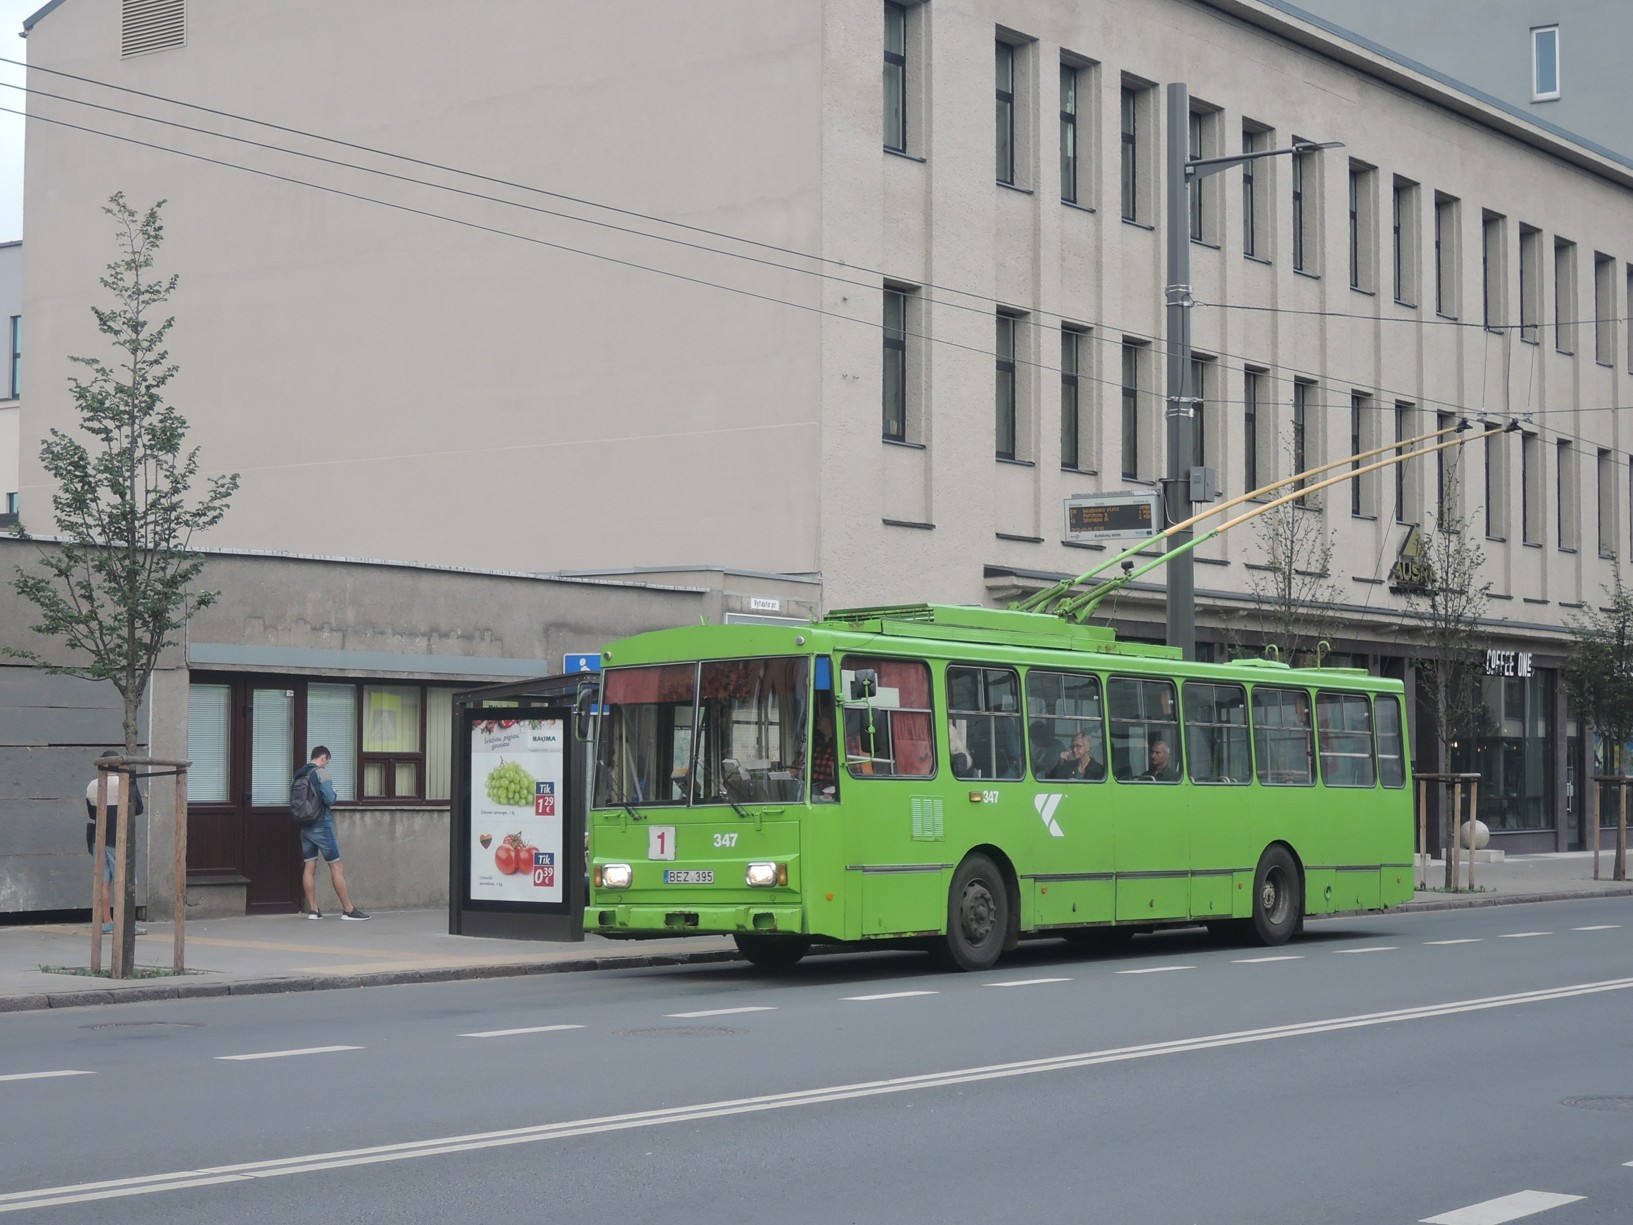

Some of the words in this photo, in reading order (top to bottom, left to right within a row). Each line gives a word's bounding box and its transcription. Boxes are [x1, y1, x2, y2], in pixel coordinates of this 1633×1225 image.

[1486, 649, 1515, 676] COFFEE
[1518, 651, 1532, 677] ONE
[539, 784, 551, 794] Tik
[983, 790, 999, 803] 347
[537, 798, 543, 813] 1
[657, 832, 665, 855] 1
[713, 833, 738, 847] 347
[538, 854, 551, 865] Tik
[534, 869, 543, 884] 0
[543, 867, 554, 877] 39
[669, 871, 690, 882] BEZ
[695, 871, 713, 882] 395
